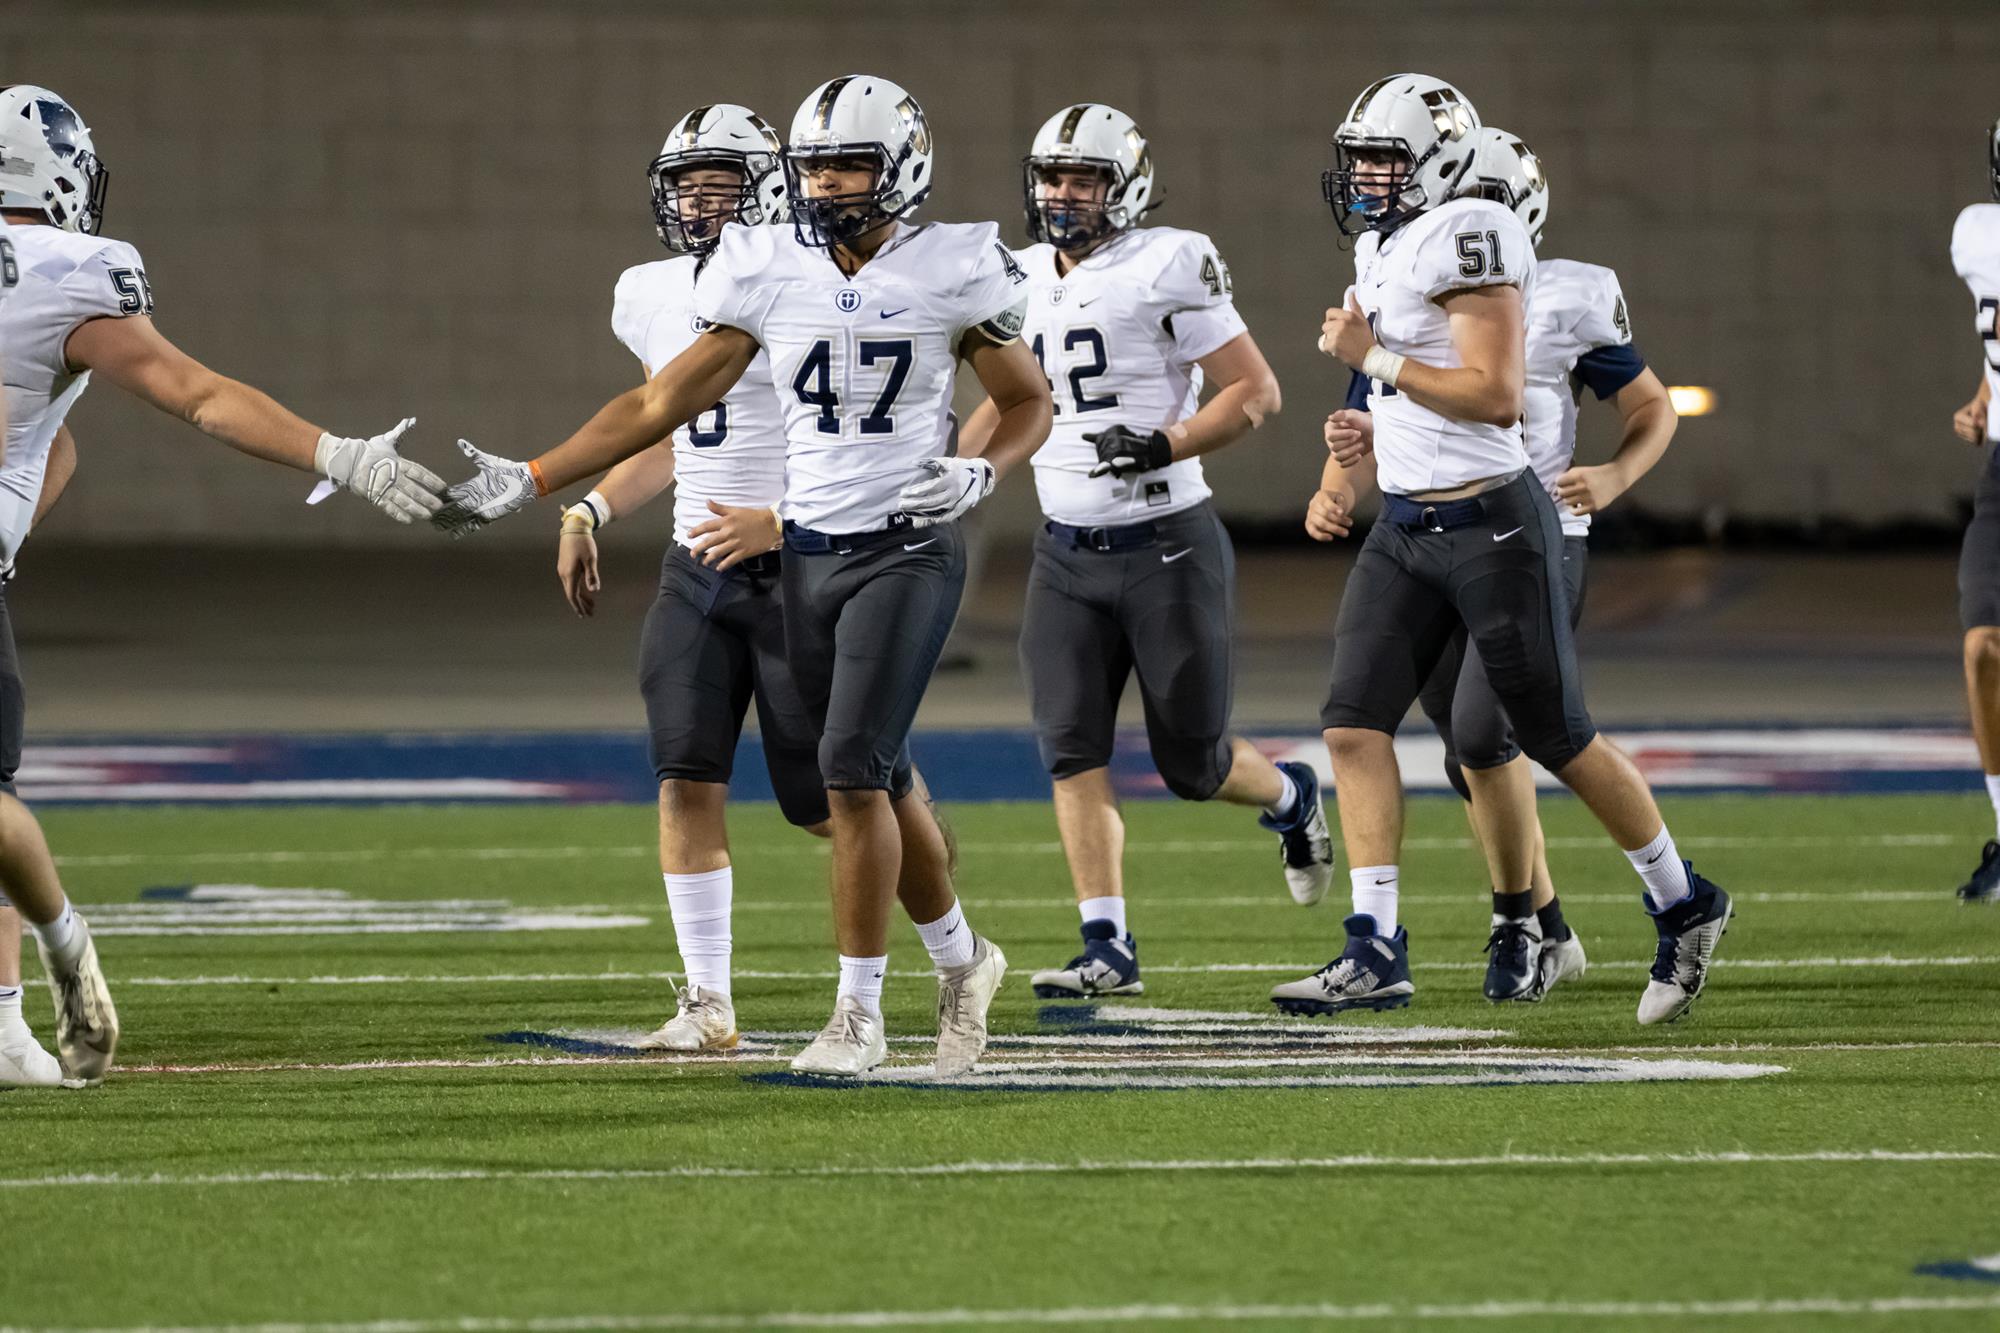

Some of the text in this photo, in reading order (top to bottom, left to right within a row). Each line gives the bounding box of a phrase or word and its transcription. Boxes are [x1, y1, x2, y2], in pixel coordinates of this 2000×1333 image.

[1455, 230, 1504, 278] 51
[791, 336, 916, 438] 47
[894, 515, 905, 525] M
